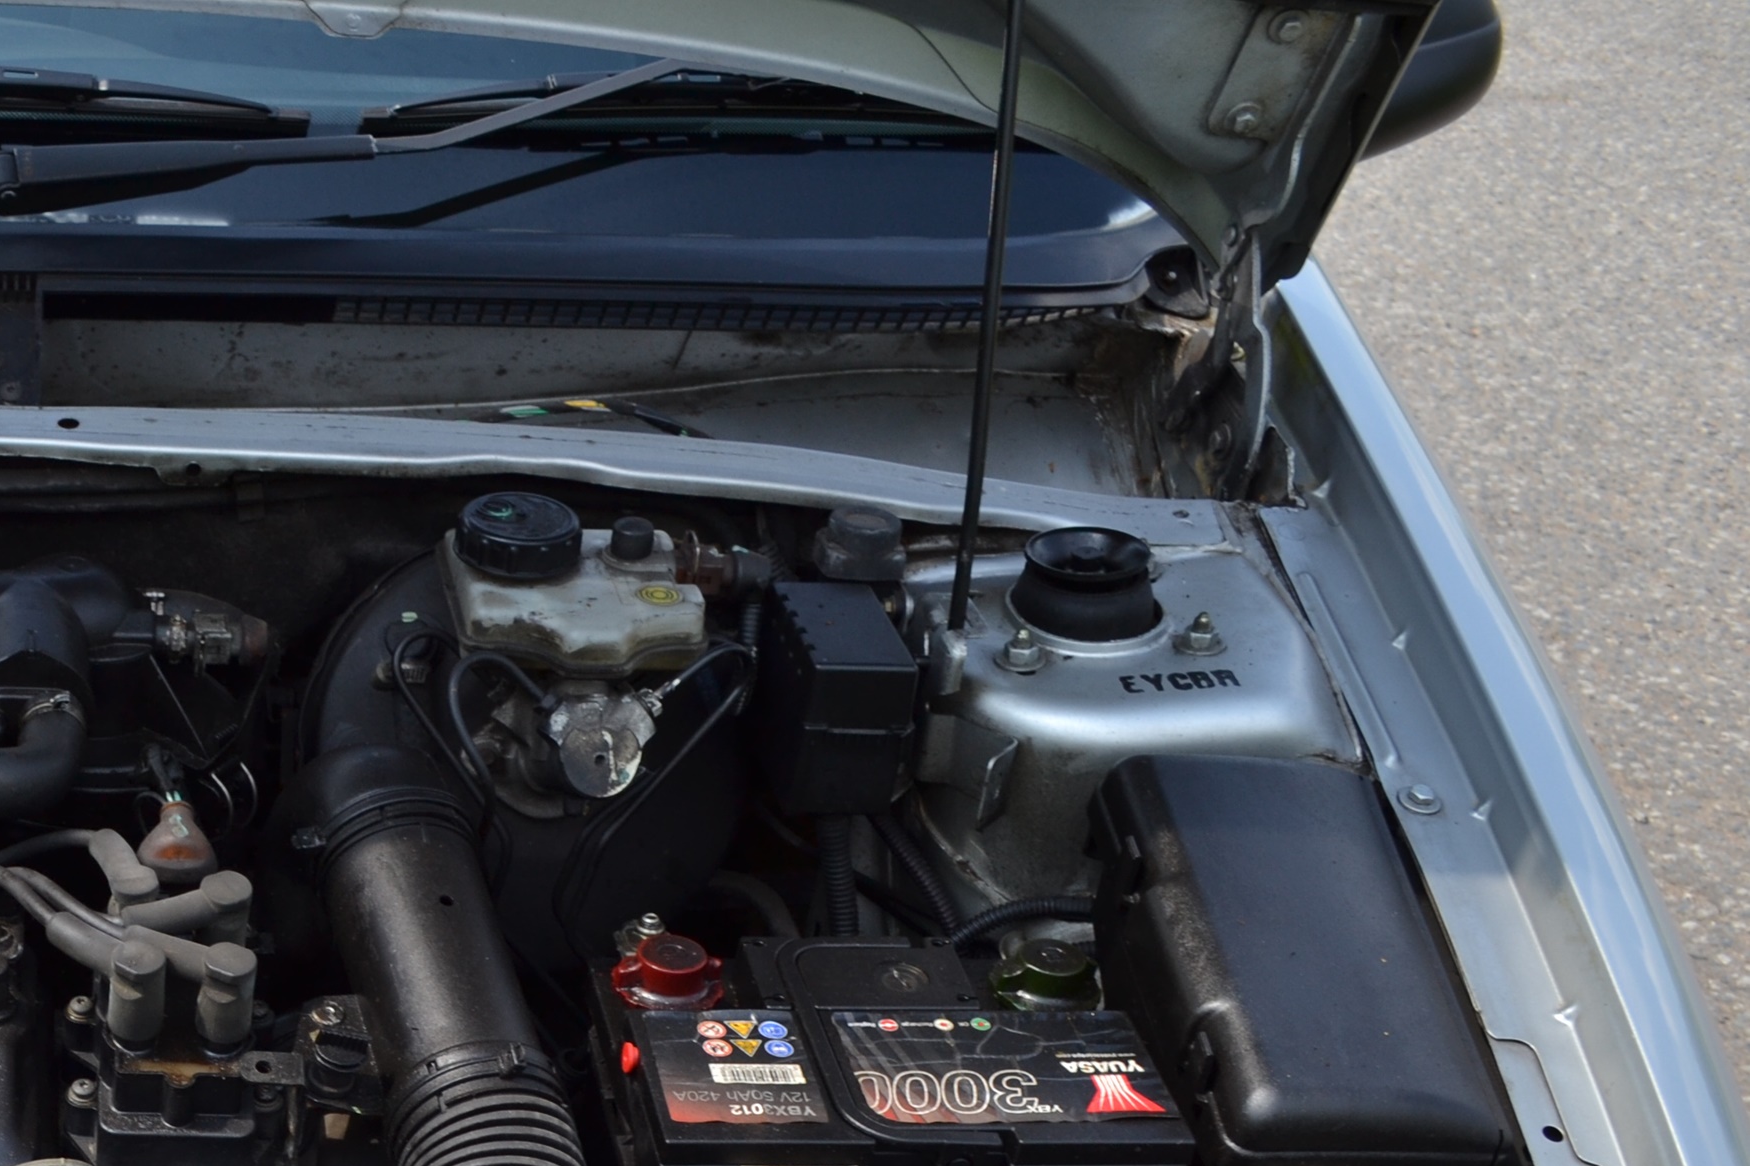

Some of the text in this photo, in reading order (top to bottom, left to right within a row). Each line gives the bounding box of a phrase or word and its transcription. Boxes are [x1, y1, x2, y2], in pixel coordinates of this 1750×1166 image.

[1060, 1060, 1146, 1074] YUASA
[672, 1089, 811, 1103] 12V 50Ah 420A
[853, 1069, 1038, 1115] 3000
[729, 1102, 817, 1117] YBX3012
[1026, 1104, 1064, 1114] YBX
